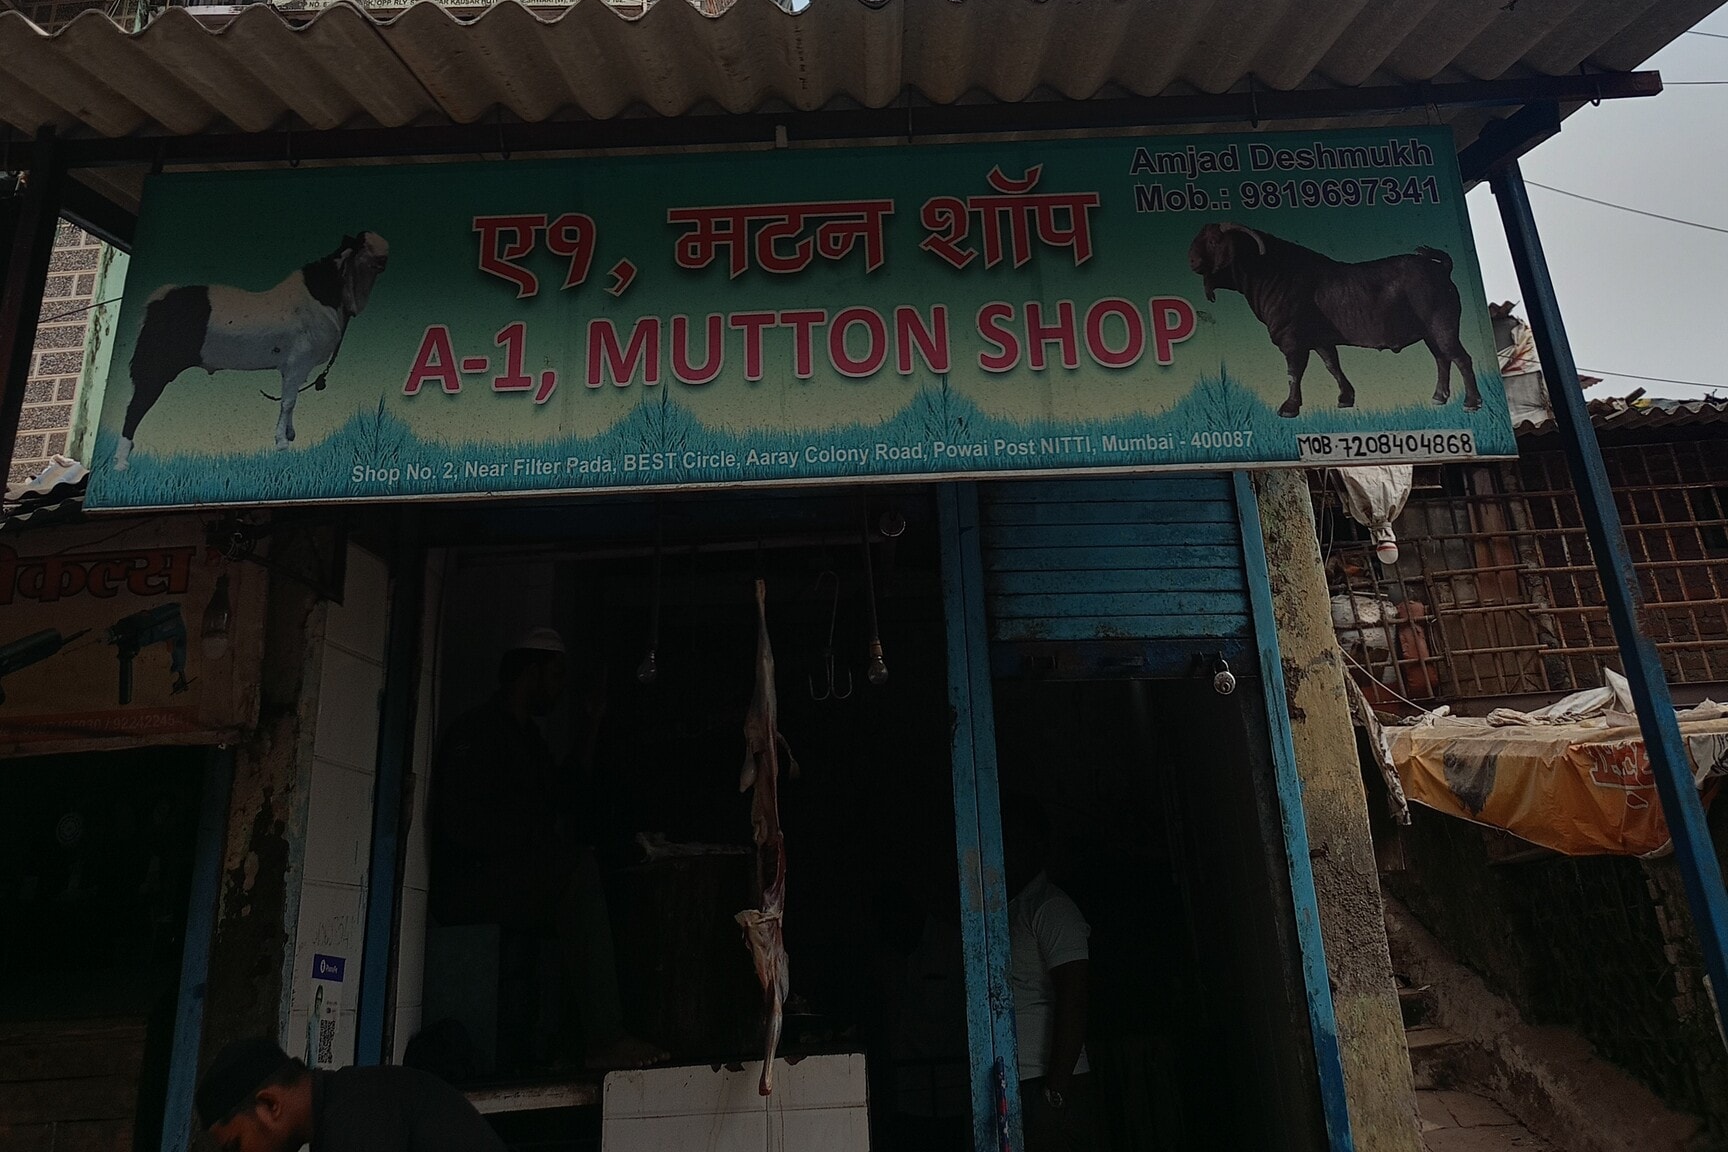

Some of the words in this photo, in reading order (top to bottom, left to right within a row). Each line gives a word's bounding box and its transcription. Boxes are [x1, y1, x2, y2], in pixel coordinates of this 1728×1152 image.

[1129, 142, 1242, 177] Amjad
[1249, 137, 1434, 170] Deshmukh
[1135, 183, 1230, 213] Mob.:
[1241, 175, 1441, 209] 9819697341
[666, 197, 896, 281] मटन
[919, 163, 1101, 270] शॉप
[404, 320, 557, 407] A-1,
[584, 302, 953, 391] MUTTON
[975, 294, 1197, 374] SHOP
[352, 463, 401, 485] Shop
[406, 462, 438, 482] No.
[464, 459, 510, 480] Near
[513, 457, 562, 477] Filter
[566, 455, 618, 477] Pada,
[623, 452, 677, 473] BEST
[682, 450, 738, 472] Circle,
[745, 448, 801, 470] Aaray
[804, 444, 871, 469] Colony
[875, 442, 929, 463] Road,
[932, 440, 989, 459] Powai
[993, 437, 1036, 457] Post
[1102, 432, 1175, 453] Mumbai
[1190, 430, 1254, 450] 400087
